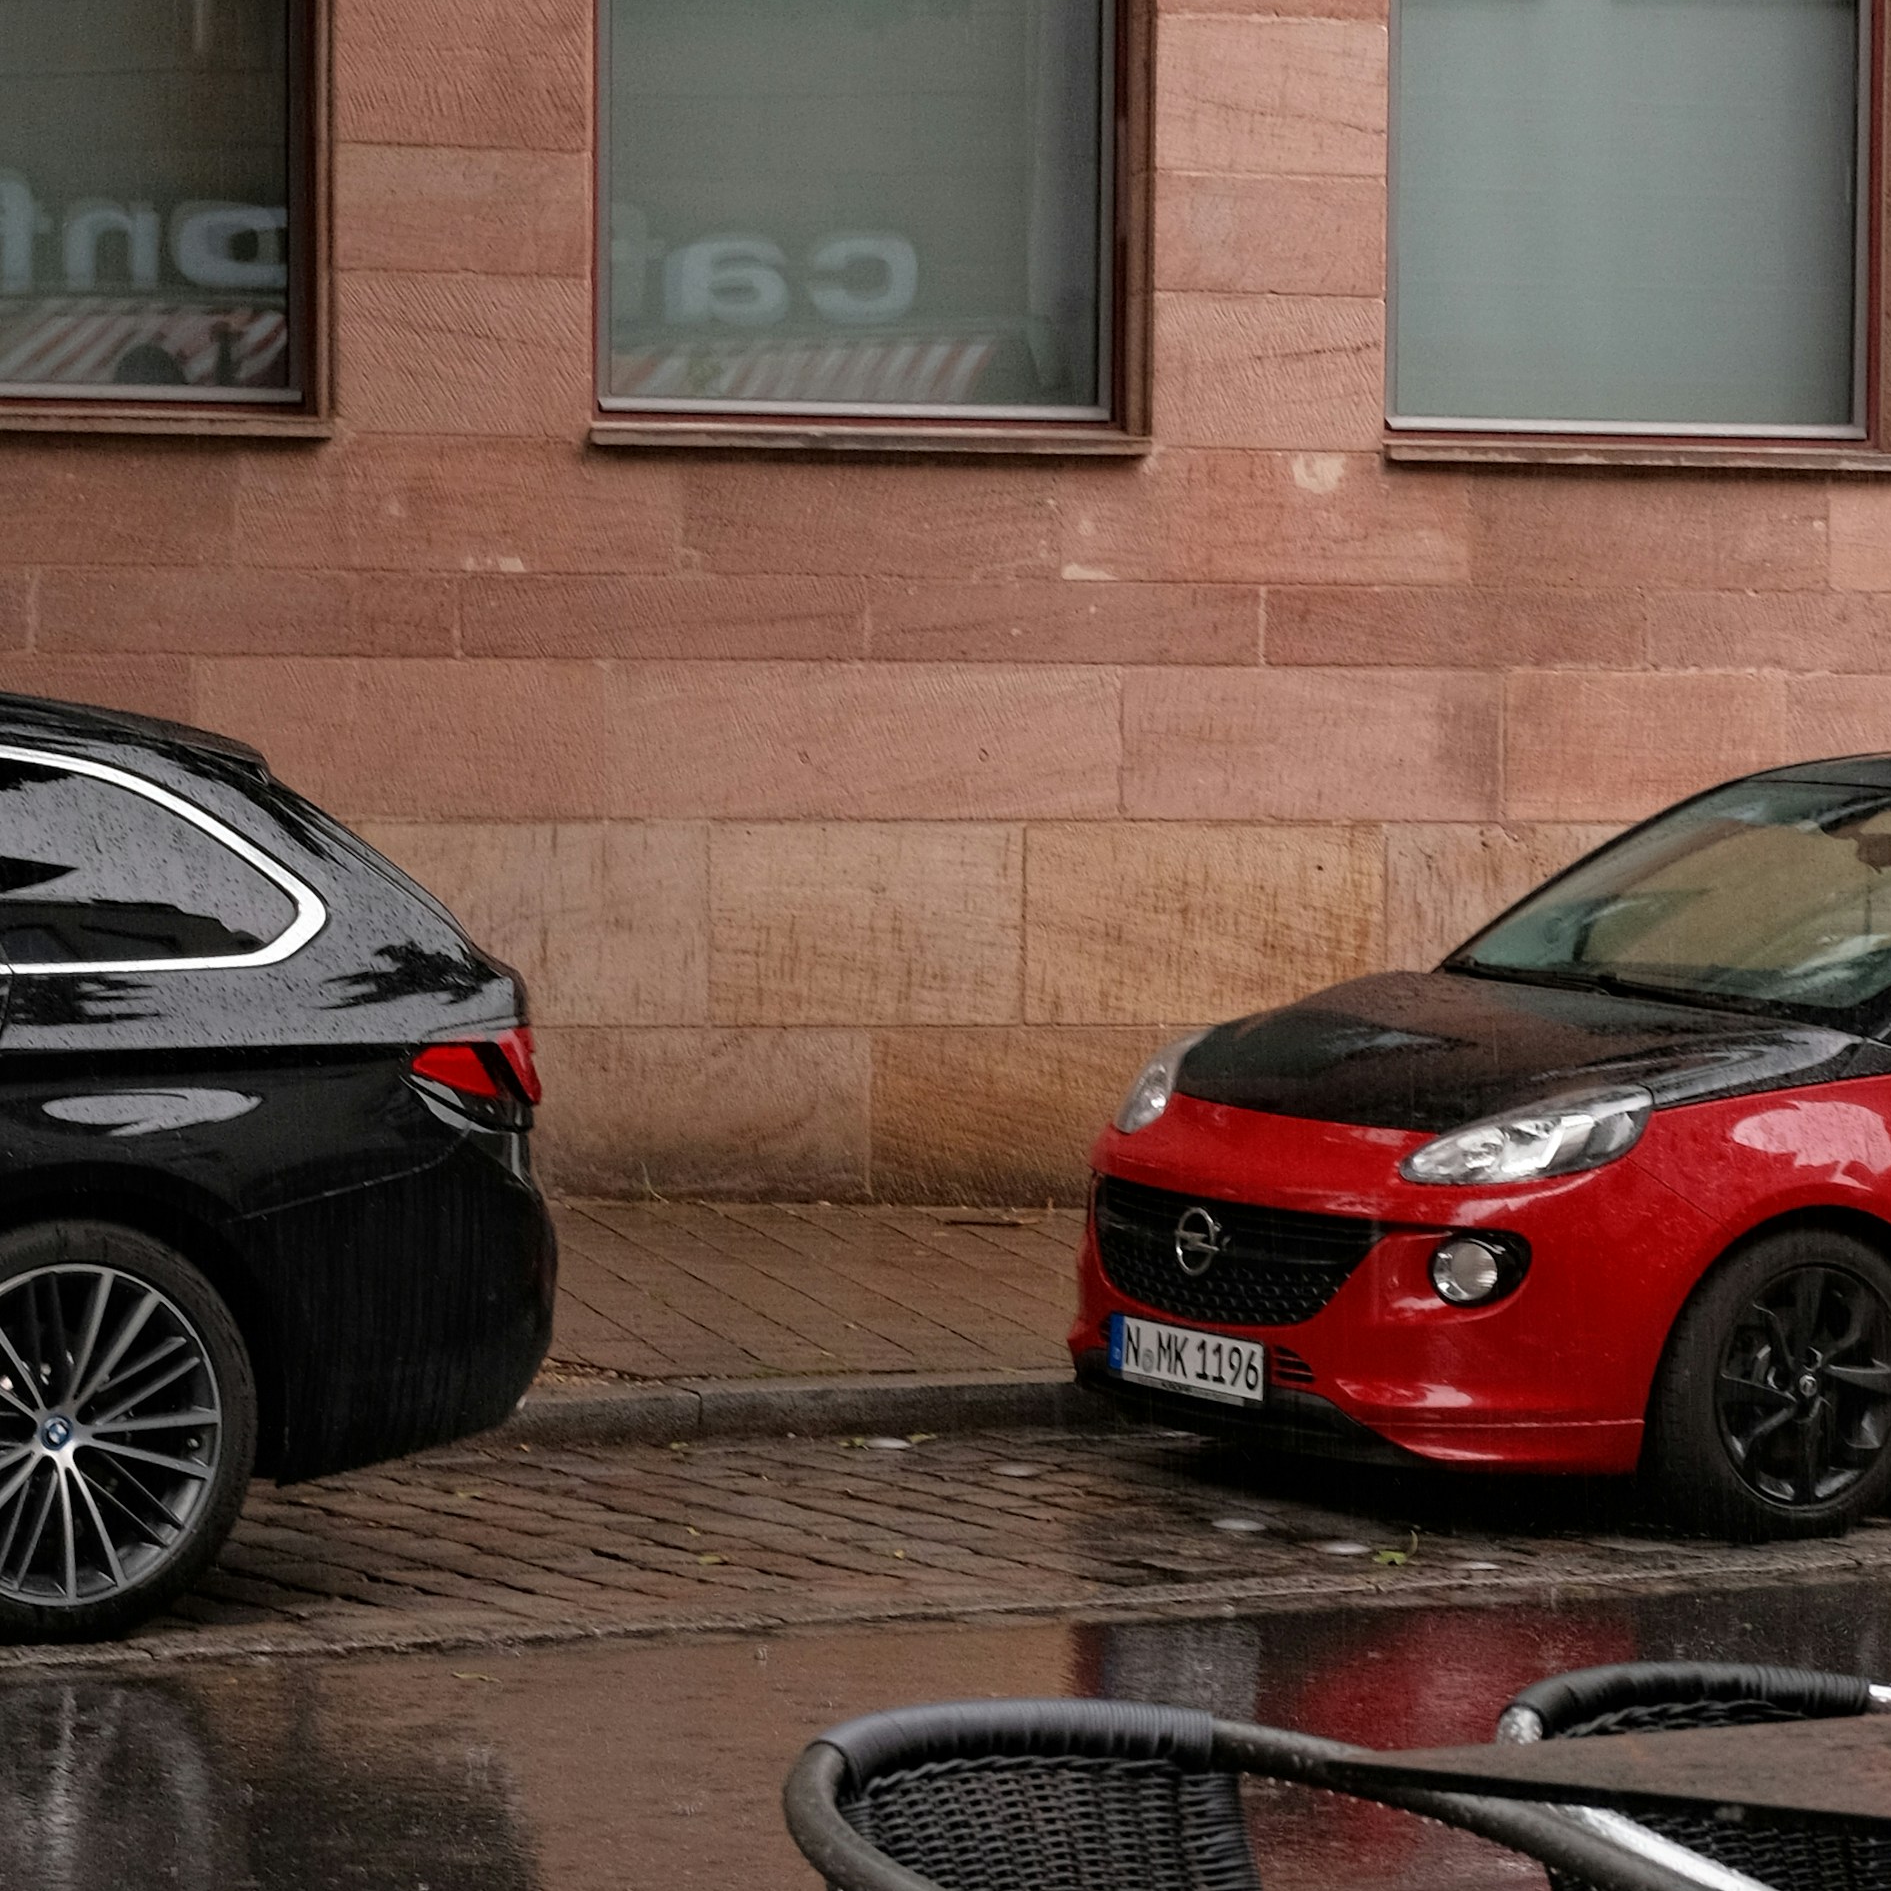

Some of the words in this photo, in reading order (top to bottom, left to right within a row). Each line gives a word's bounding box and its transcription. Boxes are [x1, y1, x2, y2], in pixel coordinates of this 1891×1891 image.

[1125, 1324, 1141, 1367] N
[1156, 1330, 1189, 1379] MK
[1195, 1338, 1260, 1391] 1196
